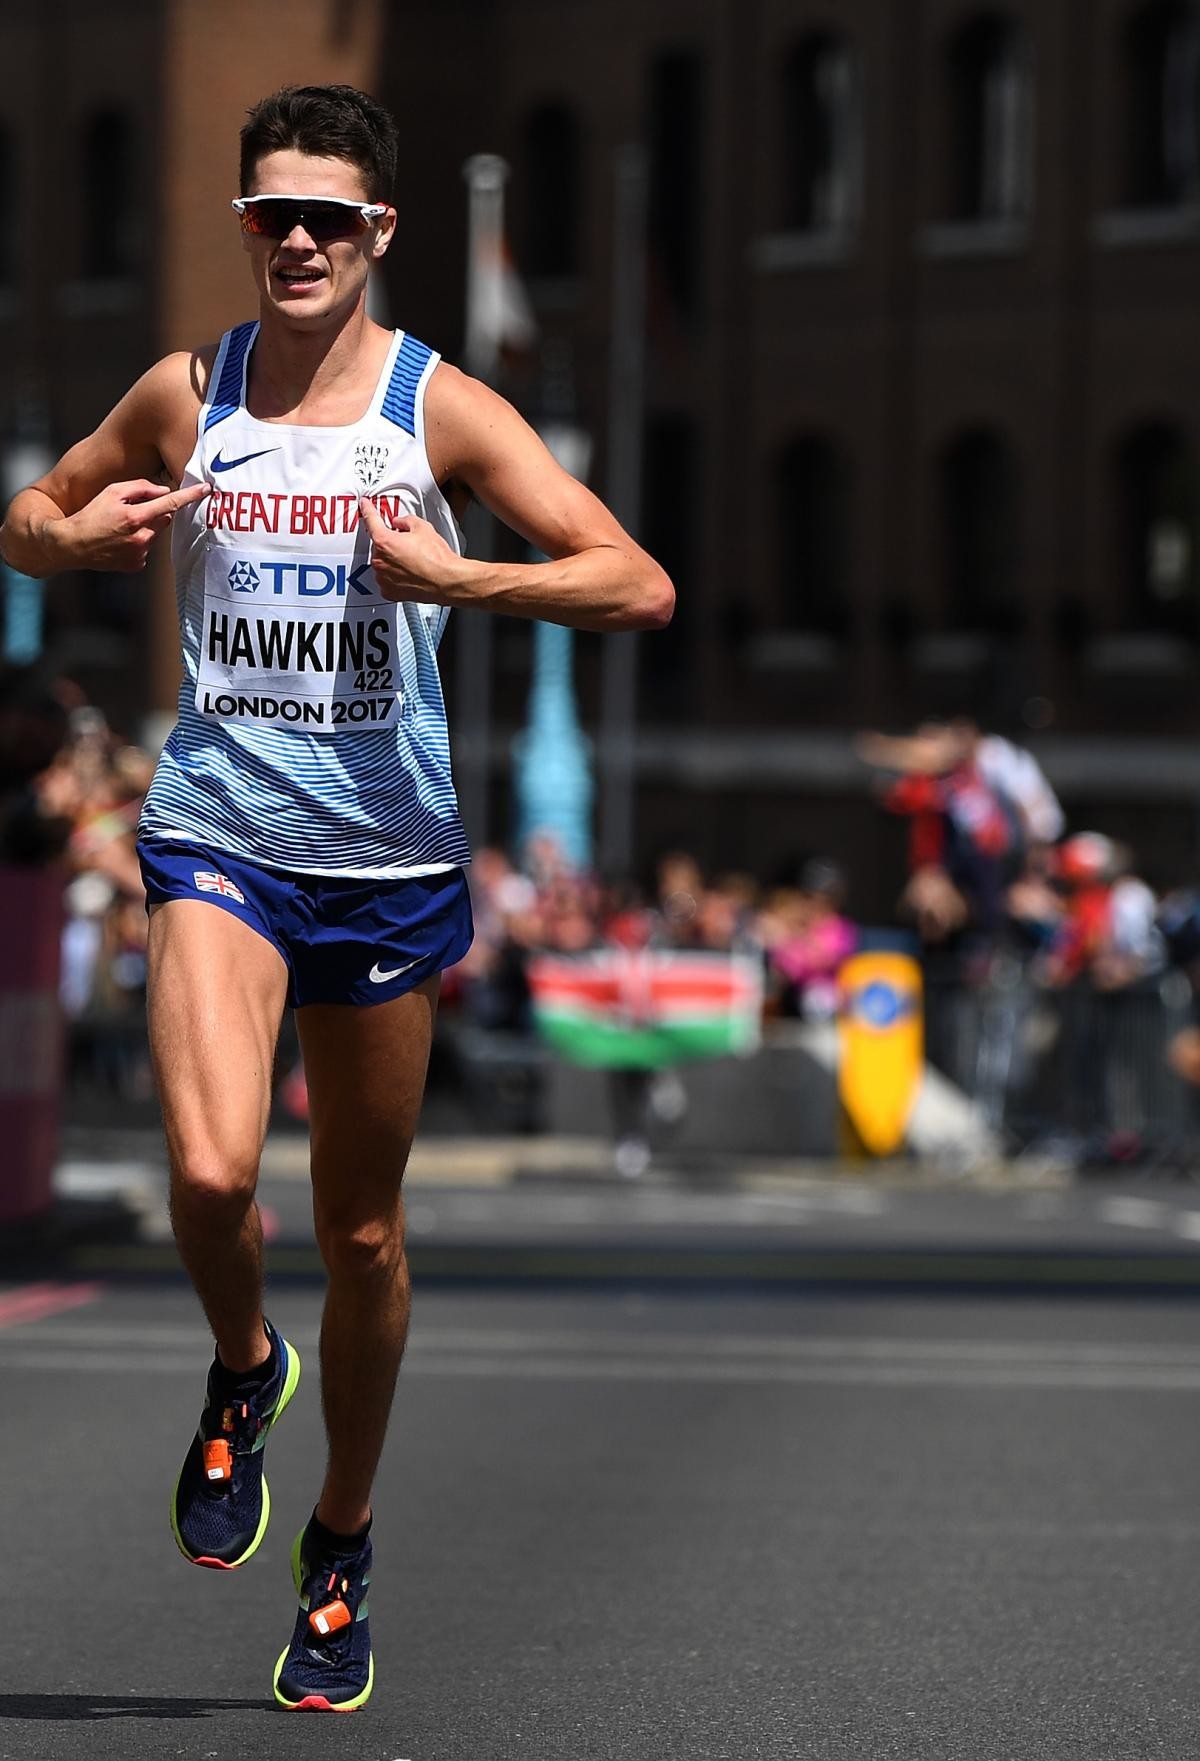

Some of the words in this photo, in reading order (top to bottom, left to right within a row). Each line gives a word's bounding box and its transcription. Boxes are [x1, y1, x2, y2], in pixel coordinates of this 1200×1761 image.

[206, 491, 288, 534] GREAT
[259, 562, 374, 597] TDK
[208, 610, 390, 673] HAWKINS
[353, 668, 394, 692] 422
[203, 692, 325, 724] LONDON
[330, 697, 396, 725] 2017
